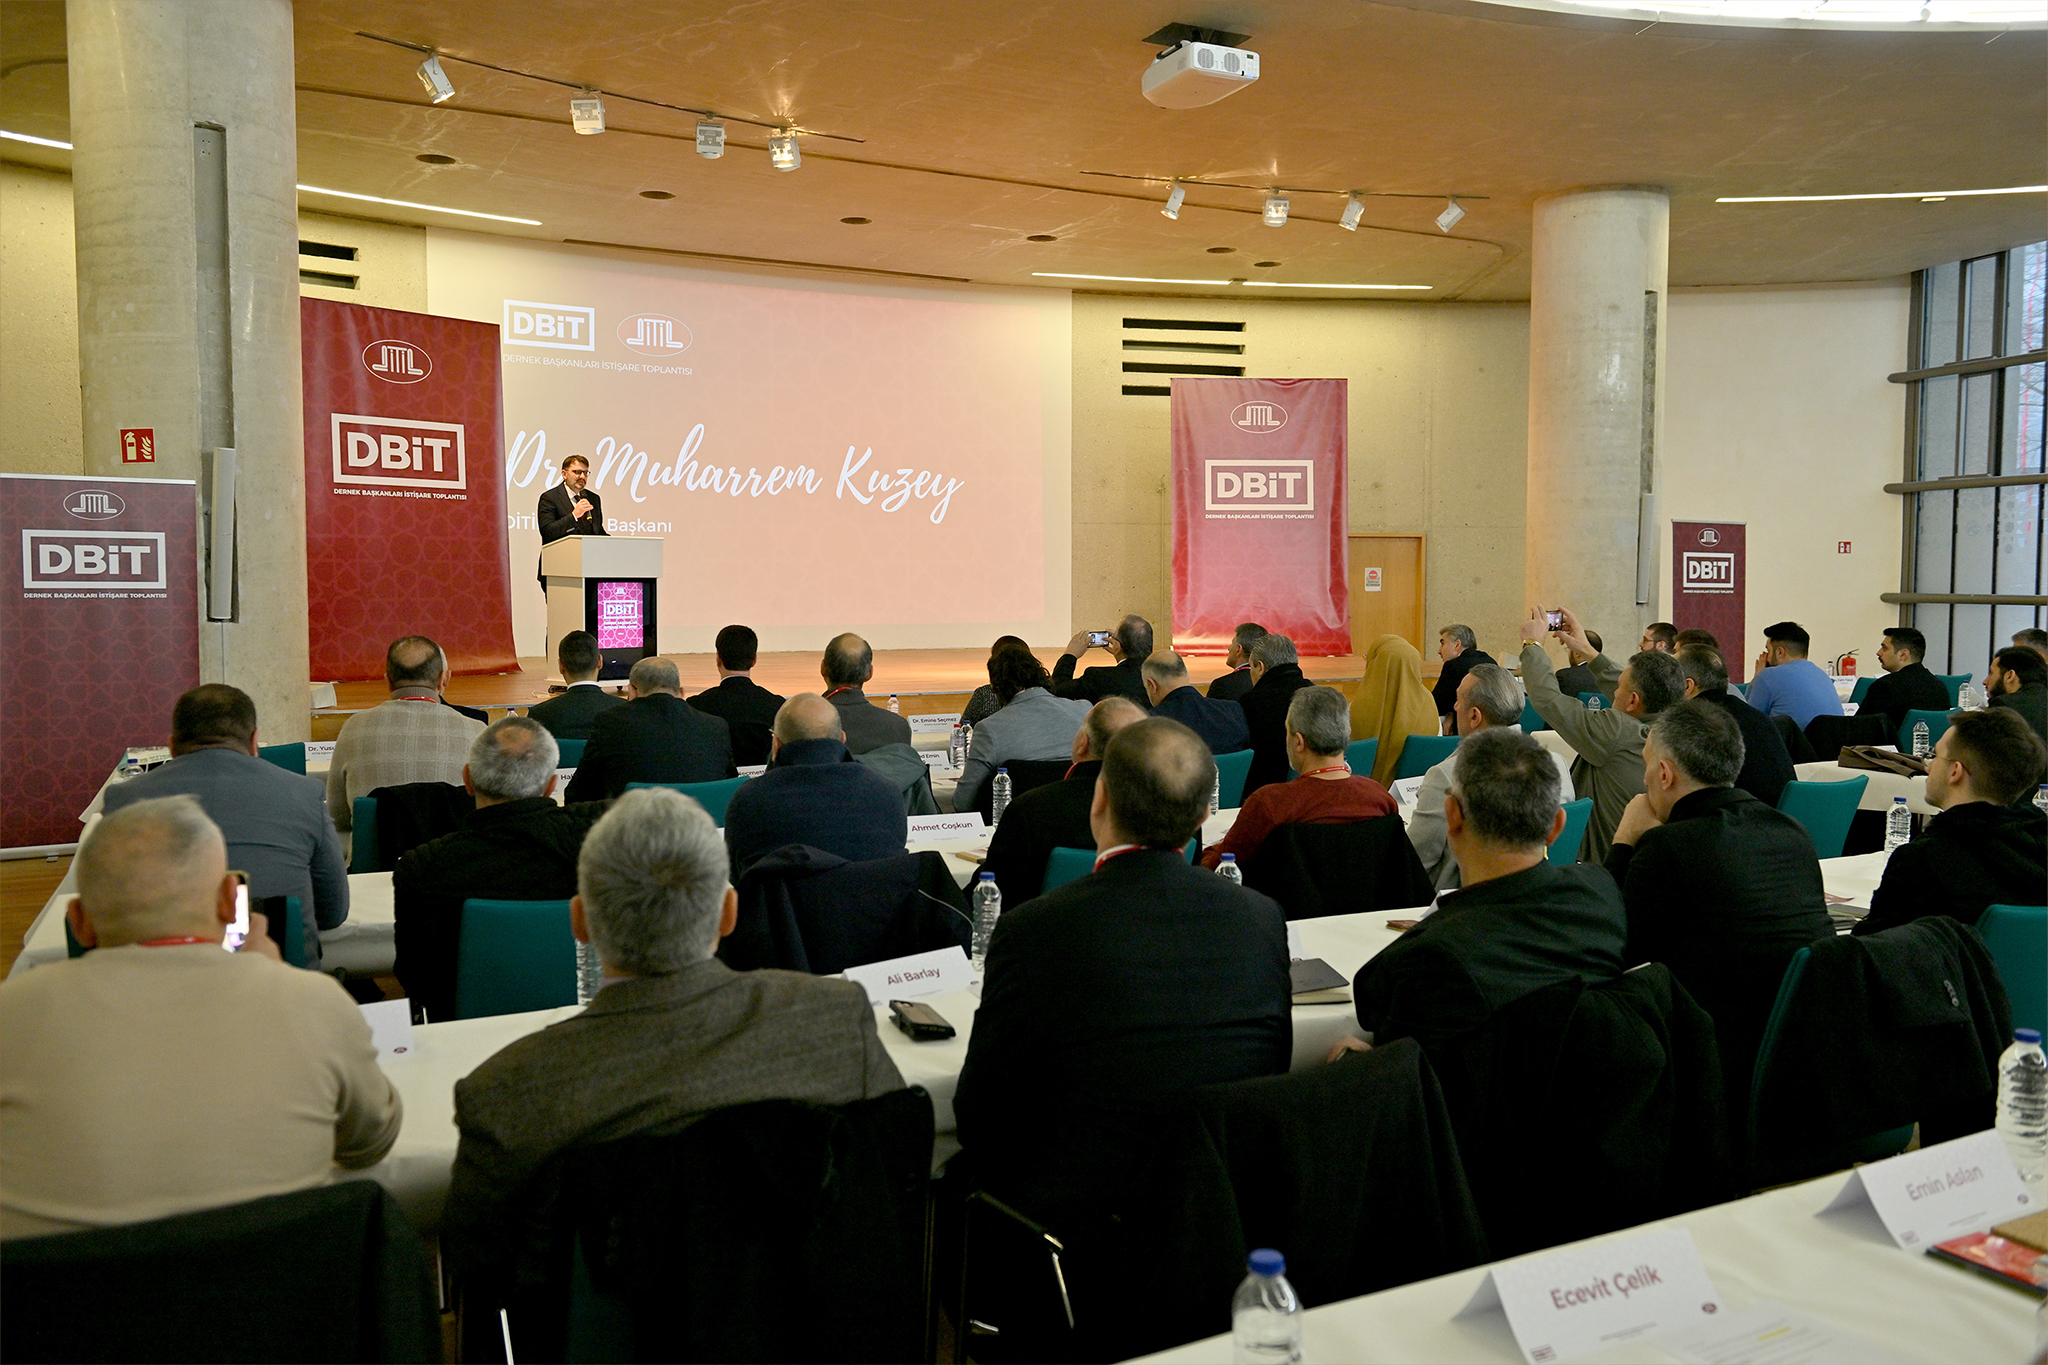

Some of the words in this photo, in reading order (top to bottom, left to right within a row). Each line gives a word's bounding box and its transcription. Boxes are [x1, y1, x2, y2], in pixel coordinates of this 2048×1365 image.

[513, 311, 585, 340] DBiT
[503, 353, 541, 365] DERNEK
[542, 357, 600, 369] BAŞKANLARI
[601, 359, 640, 373] İSTİŞARE
[642, 364, 693, 376] TOPLANTISI
[346, 431, 451, 473] DBiT
[506, 429, 563, 493] Dr
[596, 423, 823, 503] Muharrem
[835, 445, 965, 524] Kuzey
[1216, 472, 1302, 499] DBiT
[333, 488, 361, 496] DERNEK
[361, 489, 403, 498] BAŞKANLARI
[403, 489, 432, 499] İSTİŞARE
[432, 492, 467, 501] TOPLANTISI
[507, 511, 536, 530] DİTİ
[607, 517, 672, 536] Başkanı
[39, 543, 151, 575] DBiT
[1688, 560, 1729, 580] DBiT
[54, 592, 98, 600] BAŞKANLARI
[911, 824, 940, 832] Ahmet
[941, 821, 973, 831] Coşkun
[887, 974, 903, 986] Ali
[904, 968, 941, 982] Barlay
[1904, 1177, 1946, 1202] Emin
[1945, 1164, 1985, 1190] Aslan
[1550, 1278, 1613, 1312] Ecevit
[1613, 1265, 1663, 1298] Çelik
